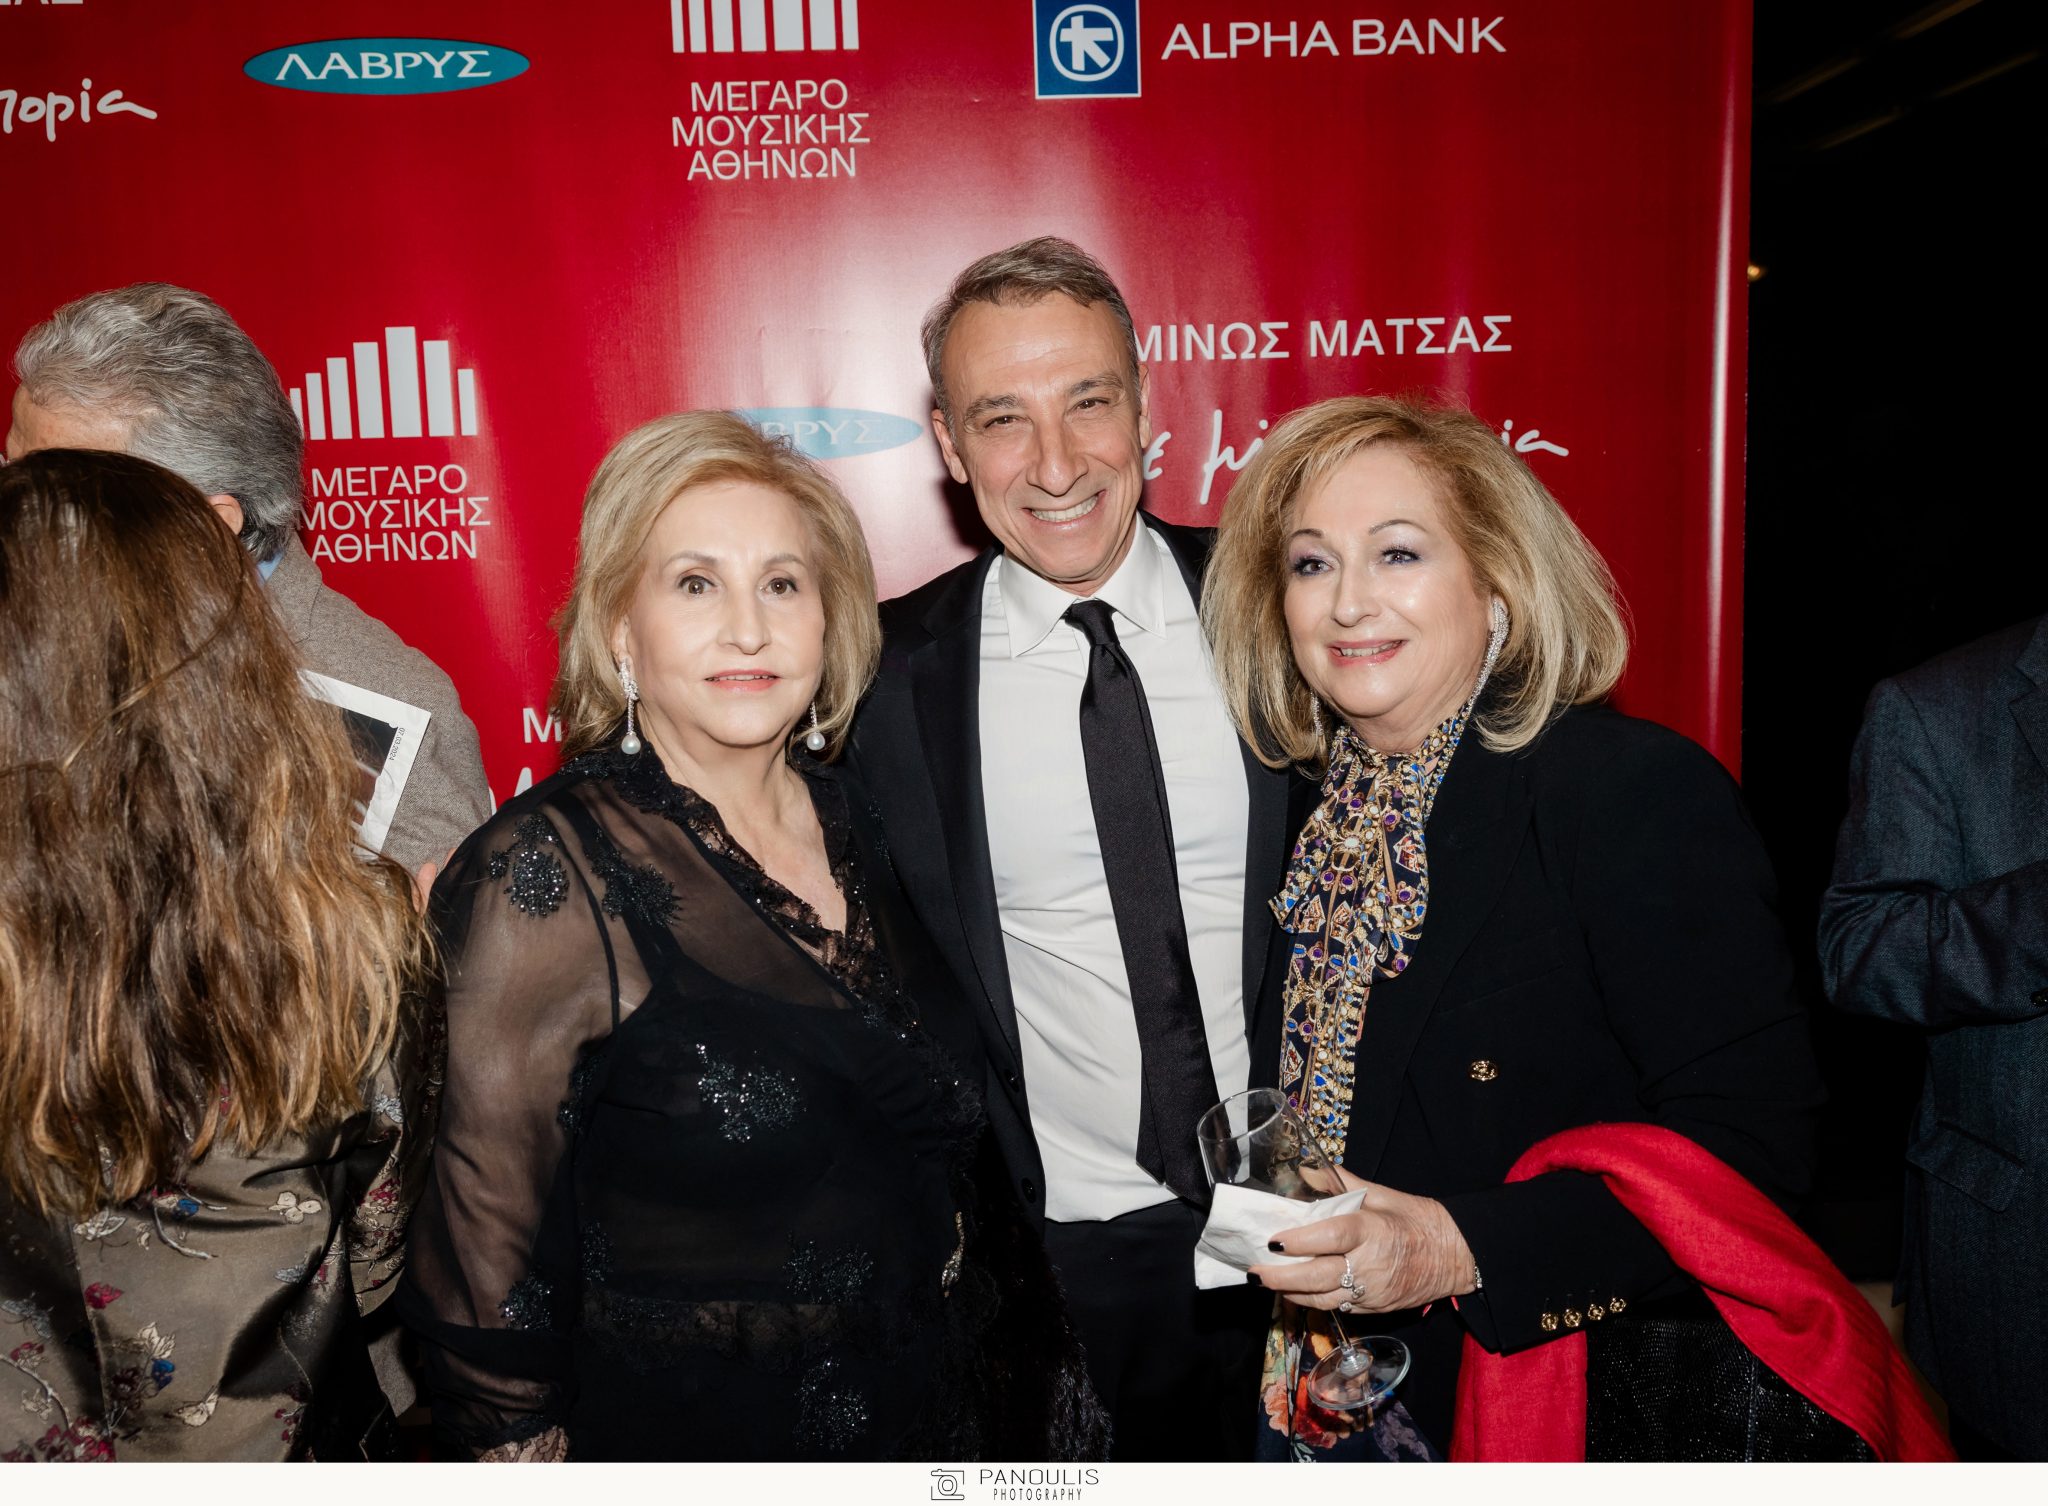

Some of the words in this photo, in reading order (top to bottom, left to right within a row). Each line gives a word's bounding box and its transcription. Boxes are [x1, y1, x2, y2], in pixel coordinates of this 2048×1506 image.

[1161, 21, 1340, 60] ALPHA
[1353, 16, 1507, 56] BANK
[275, 50, 492, 81] ΛΑΒΡΥΣ
[690, 79, 848, 112] ΜΕΓΑΡΟ
[671, 112, 871, 147] ΜΟΥΣΙΚΗΣ
[687, 147, 856, 181] ΑΘΗΝΩΝ
[1309, 315, 1513, 358] ΜΑΤΣΑΣ
[311, 463, 468, 498] ΜΕΓΑΡΟ
[311, 530, 477, 563] ΑΘΗΝΩΝ
